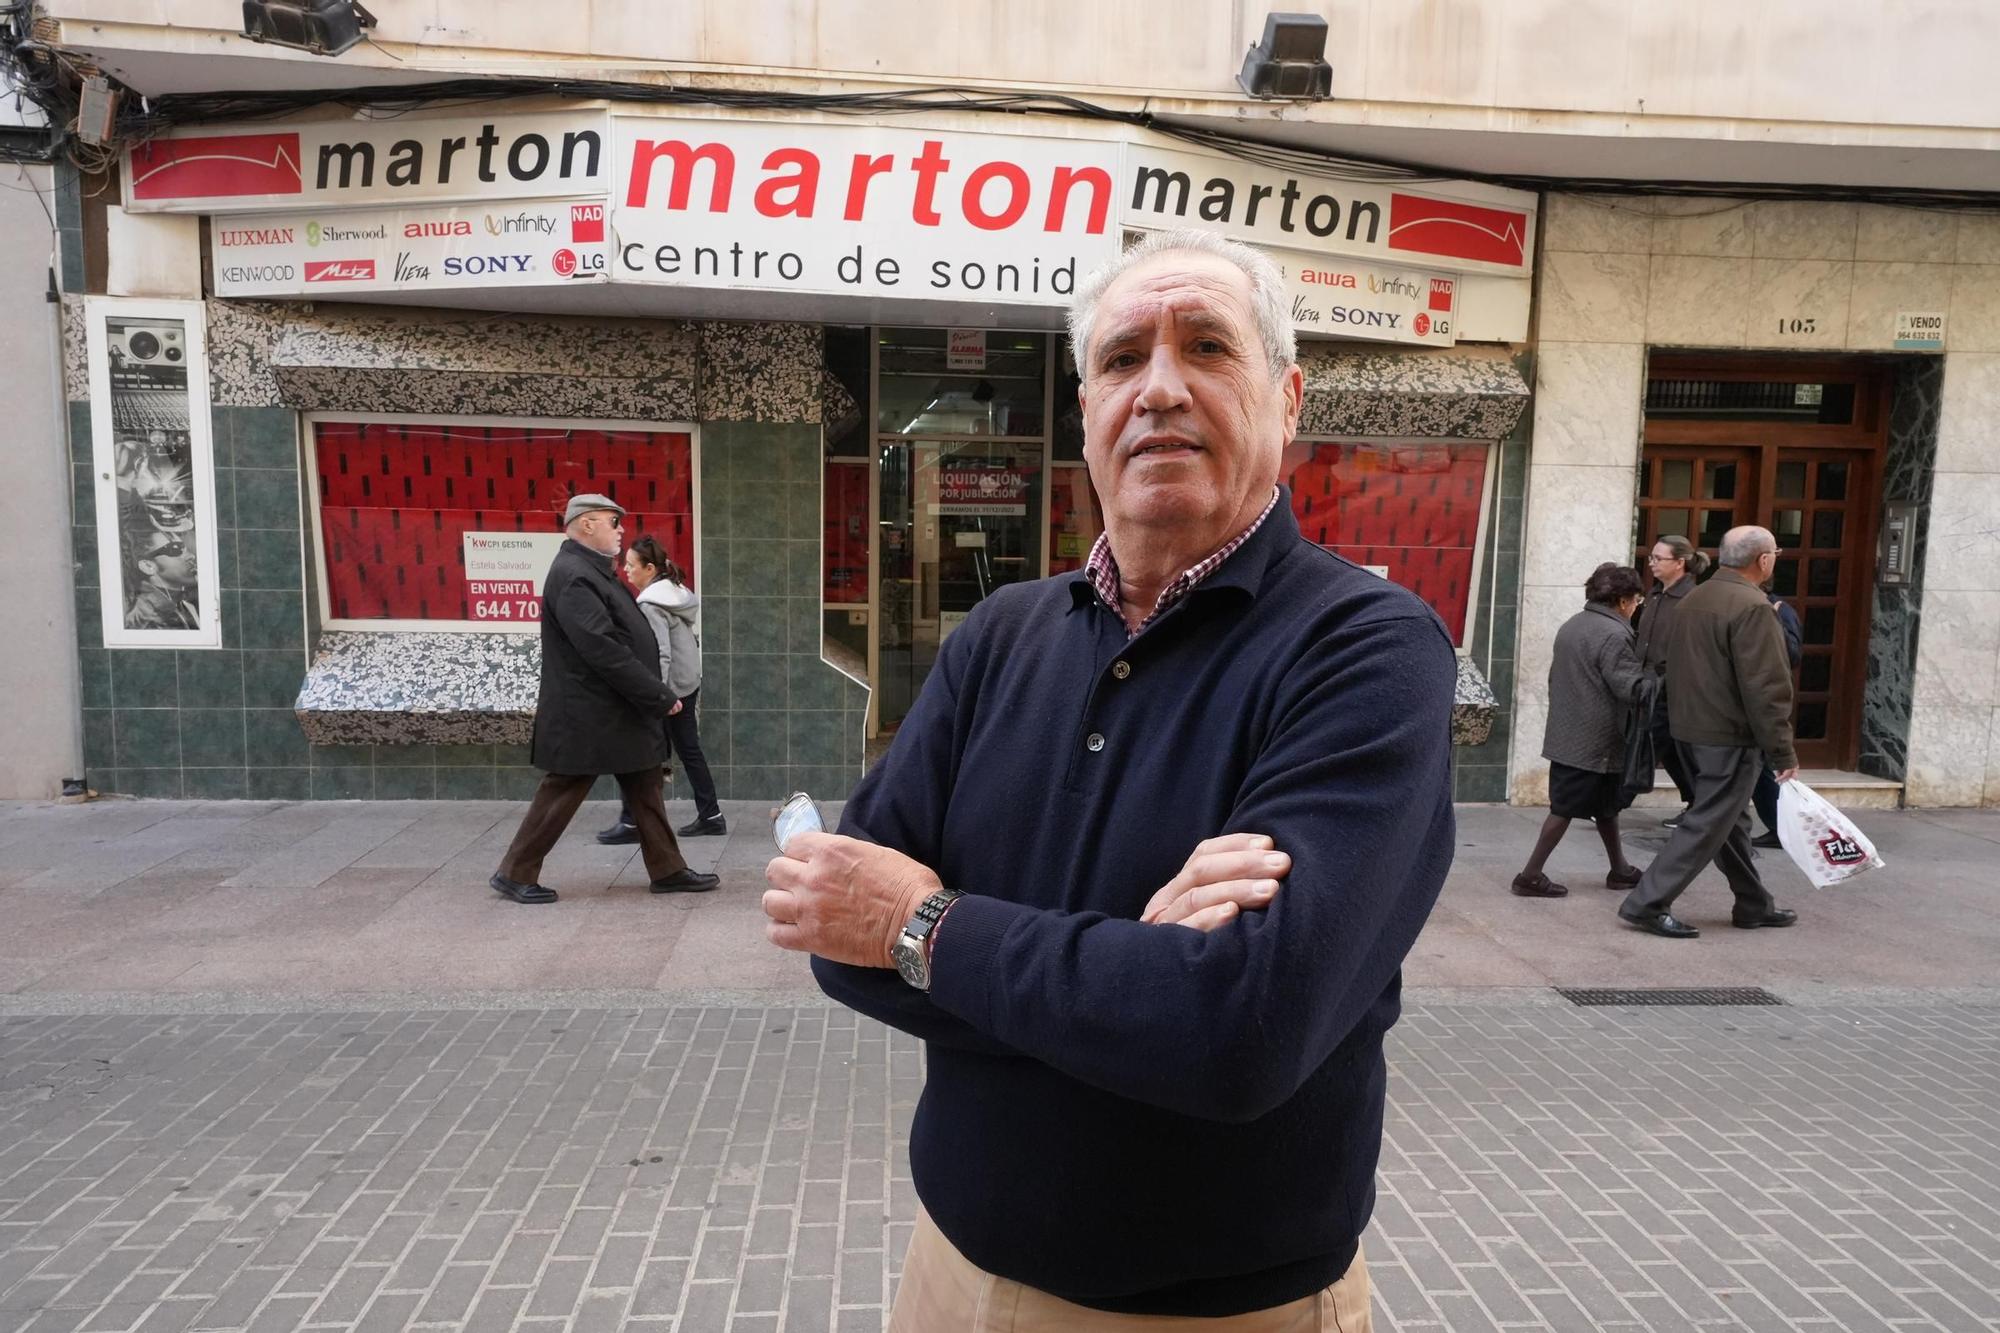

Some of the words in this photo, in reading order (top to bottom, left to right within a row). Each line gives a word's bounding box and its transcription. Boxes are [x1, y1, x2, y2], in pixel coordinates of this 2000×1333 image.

[316, 124, 600, 190] marton
[626, 140, 1113, 234] marton
[1131, 166, 1381, 243] marton
[572, 207, 603, 221] NAD
[404, 220, 472, 238] aiwa
[504, 212, 556, 235] Infinity
[220, 228, 294, 246] LUXMAN
[322, 225, 385, 241] Sherwood
[444, 255, 533, 275] SONY
[582, 254, 604, 269] LG
[622, 242, 802, 280] centro
[838, 245, 900, 284] de
[930, 257, 1075, 294] sonid
[222, 265, 294, 282] KENWOOD
[310, 264, 371, 281] Metz
[1300, 269, 1356, 289] aiwa
[1381, 277, 1422, 300] Infinity
[1430, 281, 1452, 294] NAD
[1331, 306, 1401, 329] SONY
[1910, 317, 1942, 329] VENDO
[1433, 321, 1449, 334] LG
[933, 471, 1021, 487] LIQUIDACIÓN
[940, 488, 960, 498] POR
[960, 486, 1017, 500] JUBILACIÓN
[501, 539, 533, 549] GESTIÓN
[471, 561, 495, 570] Estela
[498, 561, 532, 570] Salvador
[471, 583, 487, 594] EN
[490, 583, 529, 595] VENTA
[475, 601, 511, 618] 644
[515, 601, 542, 618] 70
